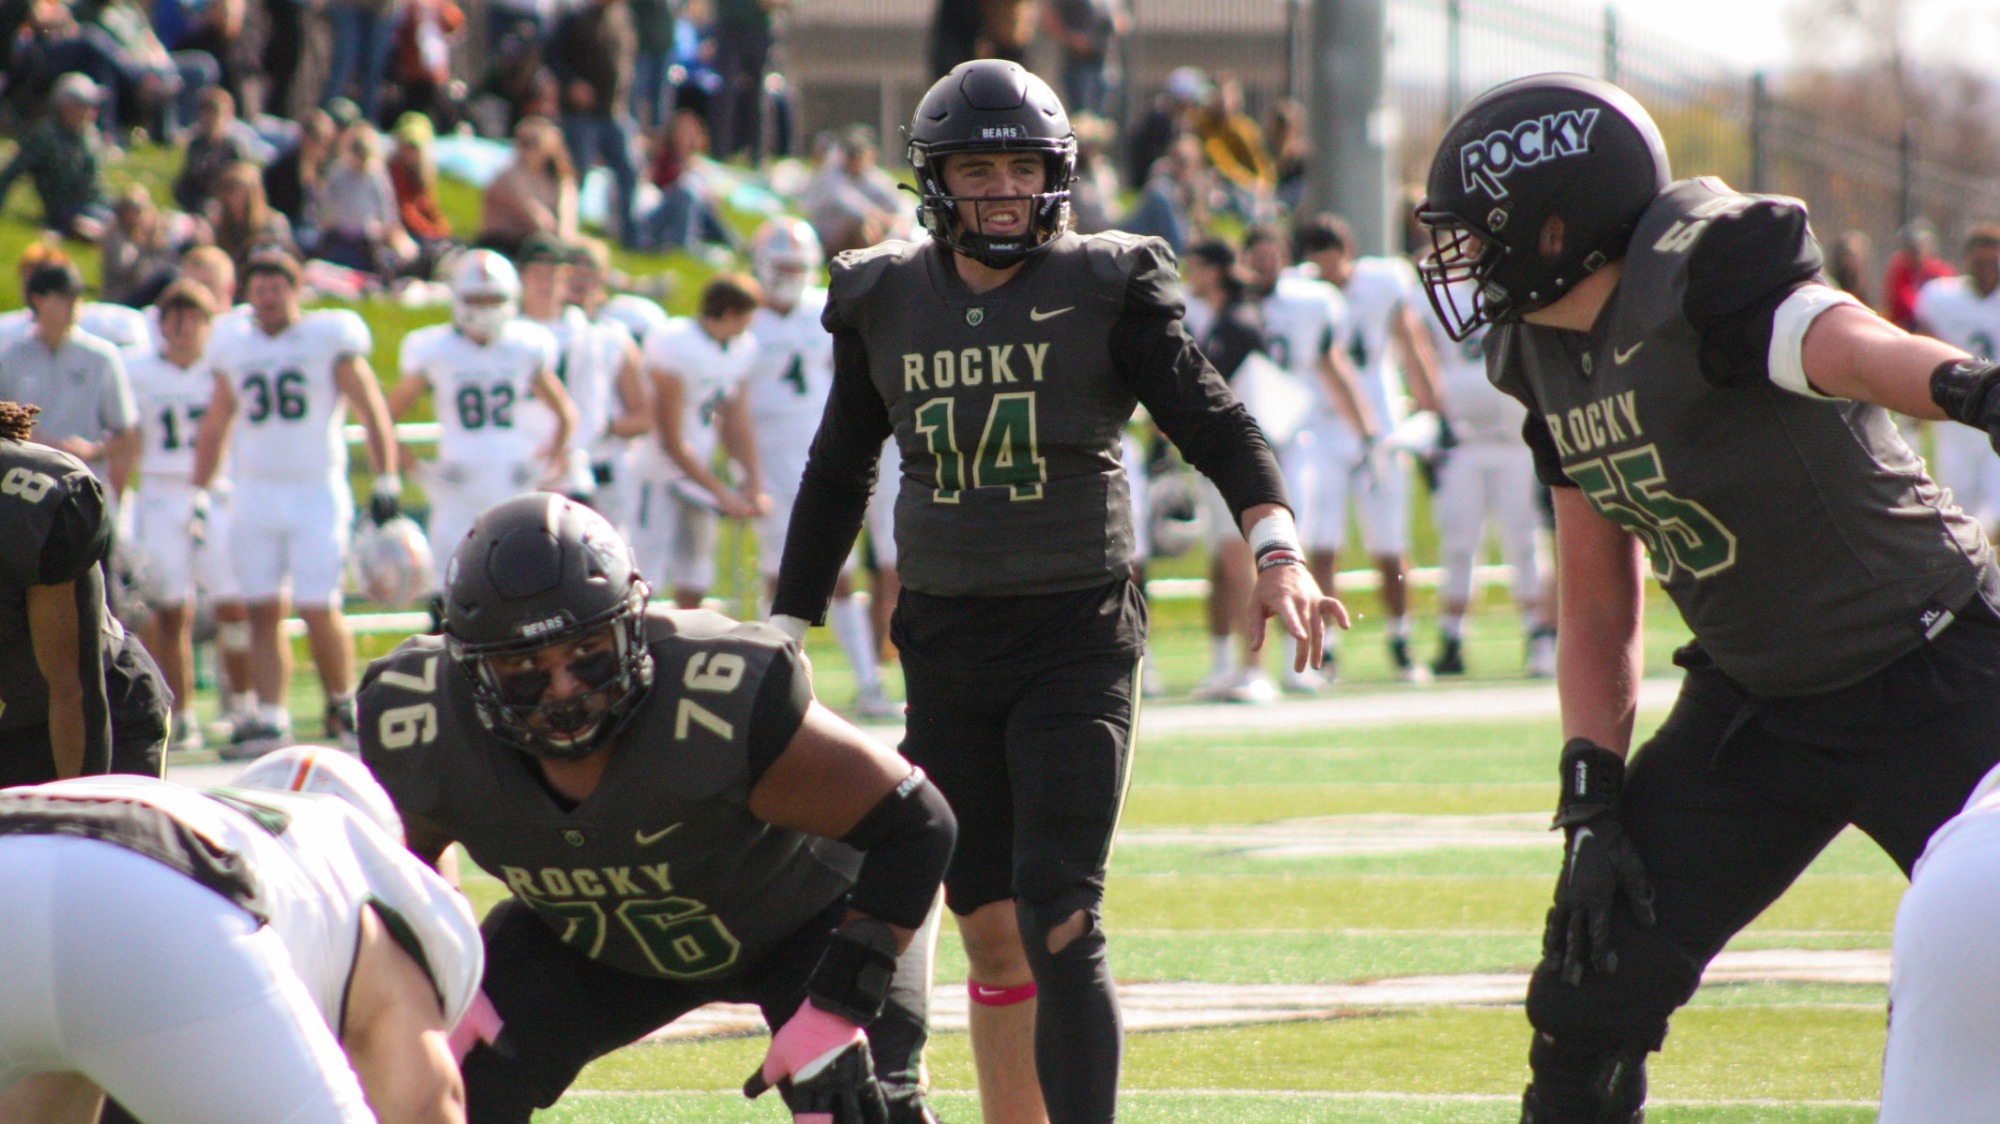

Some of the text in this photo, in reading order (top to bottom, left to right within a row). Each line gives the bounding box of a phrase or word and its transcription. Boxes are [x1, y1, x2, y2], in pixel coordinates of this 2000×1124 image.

[982, 127, 1018, 138] BEARS
[1461, 108, 1600, 200] ROCKY
[902, 342, 1051, 393] ROCKY
[242, 368, 308, 424] 36
[456, 381, 516, 431] 82
[1545, 390, 1644, 458] ROCKY
[915, 390, 1048, 504] 14
[0, 466, 55, 504] 8
[1562, 442, 1737, 583] 55
[522, 615, 564, 639] BEARS
[1919, 609, 1941, 628] XL
[379, 656, 438, 750] 76
[674, 651, 746, 742] 76
[501, 863, 674, 897] ROCKY
[515, 895, 741, 978] 76
